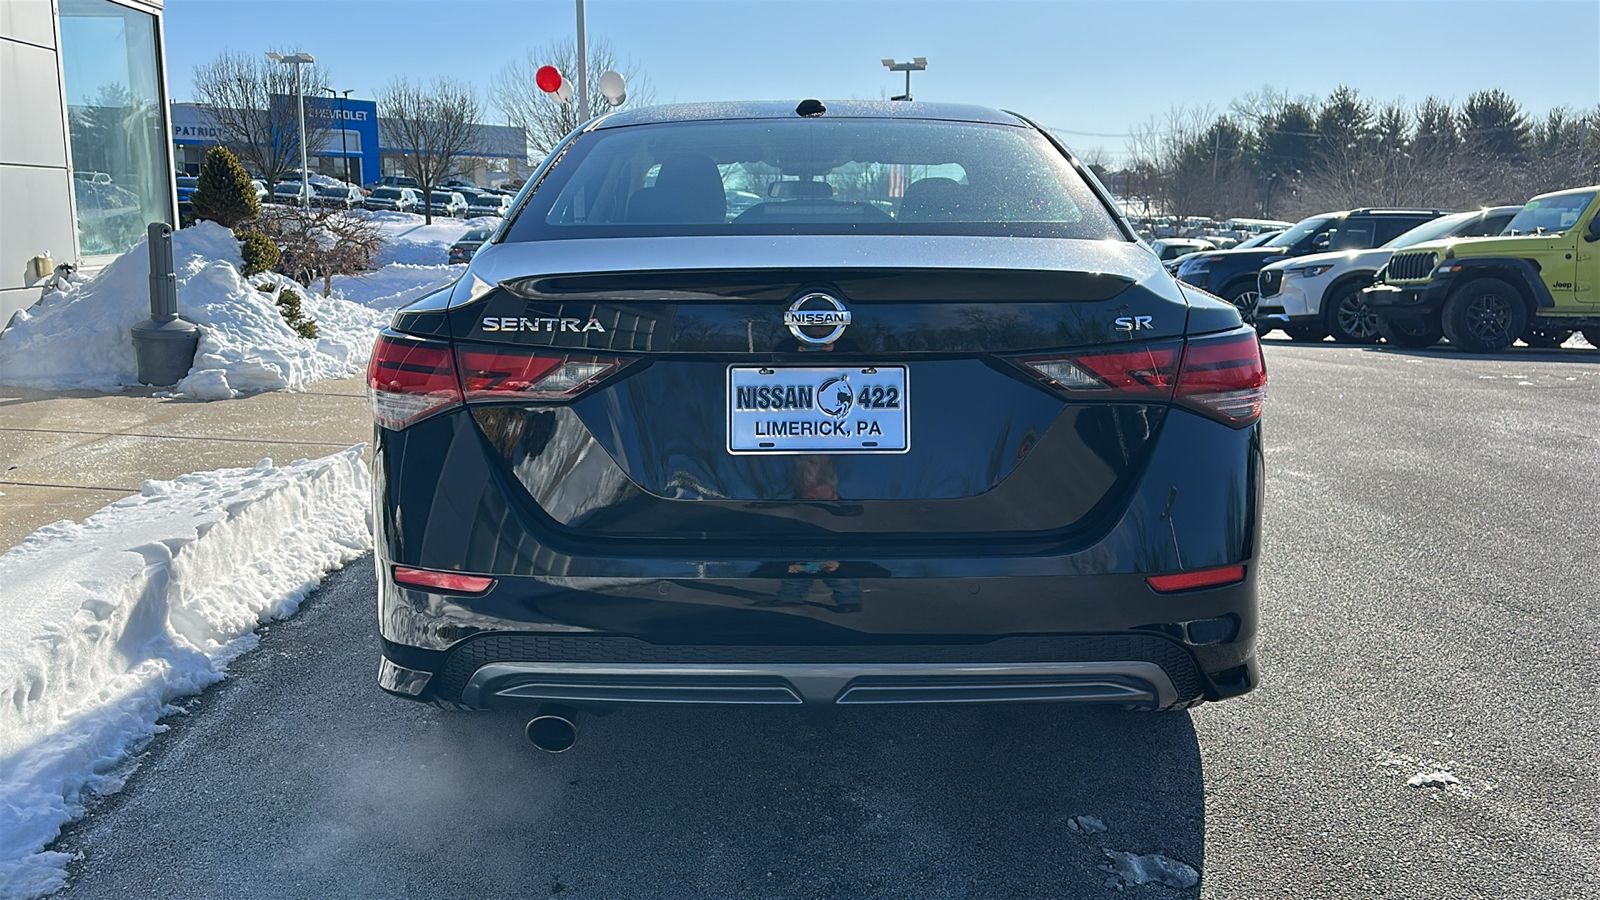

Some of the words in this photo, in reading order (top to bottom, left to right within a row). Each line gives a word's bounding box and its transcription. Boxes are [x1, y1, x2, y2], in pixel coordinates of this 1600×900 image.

[175, 126, 223, 137] PATRIOT
[1552, 281, 1572, 289] Jeep
[482, 317, 606, 333] SENTRA
[791, 313, 844, 322] NISSAN
[1115, 315, 1154, 331] SR
[736, 385, 813, 410] NISSAN
[857, 385, 900, 410] 422
[755, 421, 851, 437] LIMERICK,
[857, 420, 882, 436] PA
